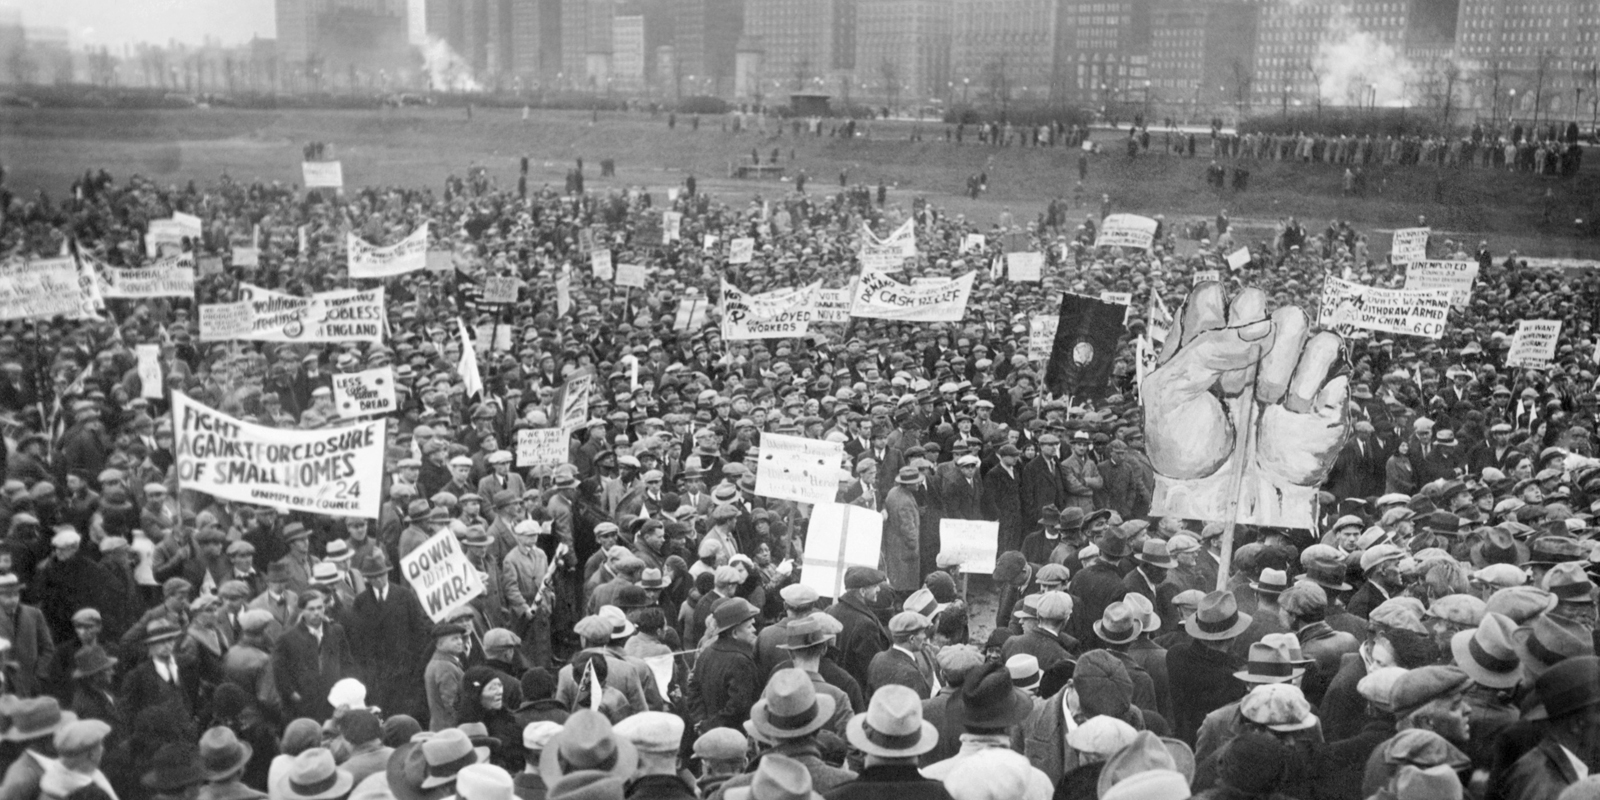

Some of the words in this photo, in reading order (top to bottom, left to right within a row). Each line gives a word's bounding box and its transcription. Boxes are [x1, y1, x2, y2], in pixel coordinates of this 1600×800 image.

[1411, 261, 1467, 271] UNEMPLOYED
[162, 279, 193, 292] UNION
[861, 272, 879, 286] WE
[820, 292, 840, 301] VOTE
[861, 278, 896, 303] DEMAND
[880, 290, 914, 307] CASH
[318, 305, 380, 324] JOBLESS
[817, 309, 835, 320] NOV
[1411, 306, 1444, 320] ARMED
[747, 322, 797, 333] WORKERS
[1378, 316, 1407, 327] CHINA
[1535, 324, 1556, 332] WANT
[326, 323, 377, 336] ENGLAND
[336, 377, 362, 389] LESS
[359, 398, 389, 411] BREAD
[182, 404, 241, 438] FIGHT
[178, 432, 254, 461] AGAINST
[254, 424, 376, 464] FORCLOSURE
[179, 459, 206, 482] OF
[213, 461, 280, 485] SMALL
[284, 452, 356, 488] HOMES
[316, 499, 361, 511] COUNCIL
[408, 534, 453, 580] DOWN
[426, 563, 471, 616] WAR!
